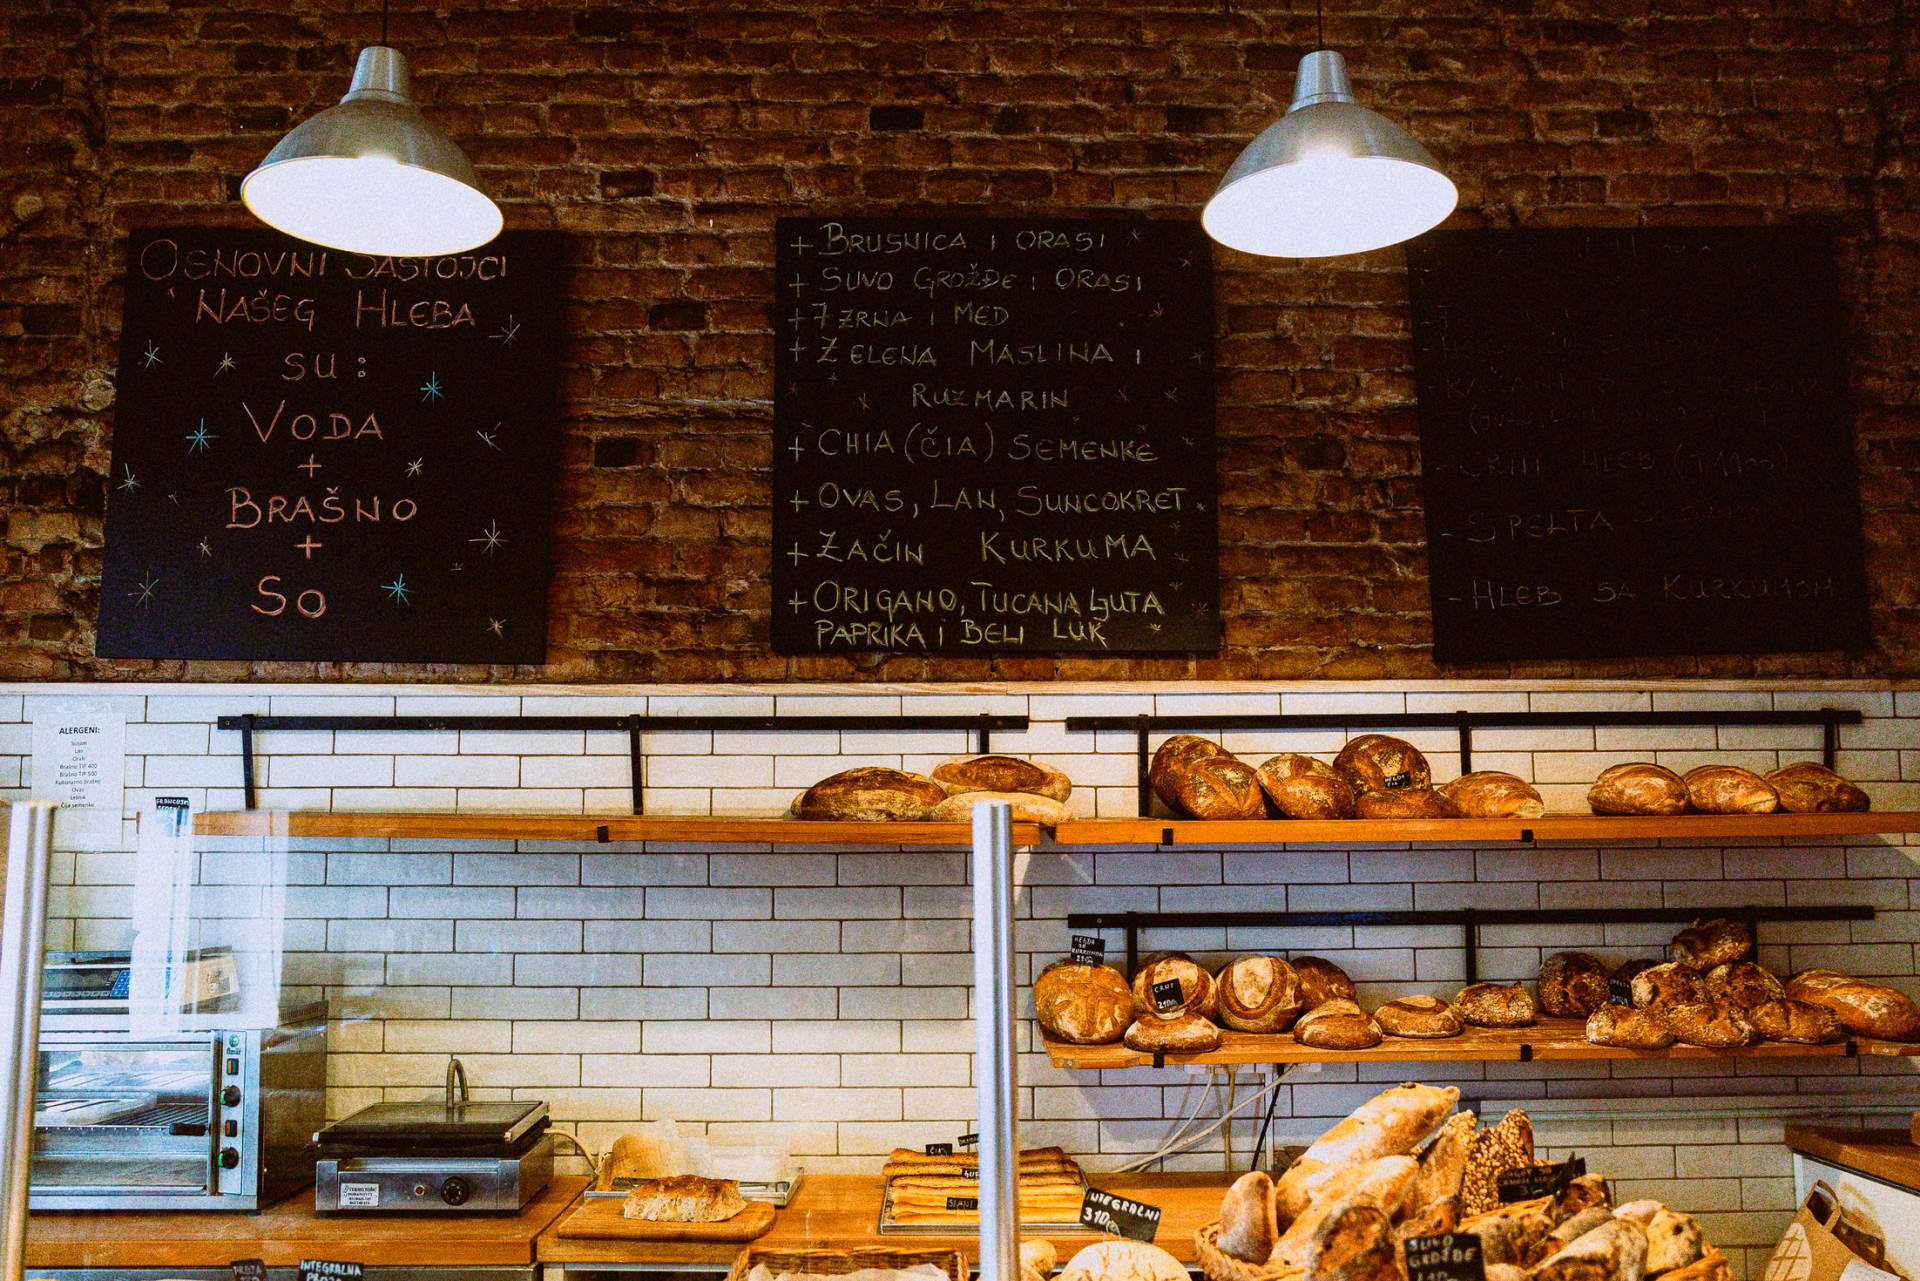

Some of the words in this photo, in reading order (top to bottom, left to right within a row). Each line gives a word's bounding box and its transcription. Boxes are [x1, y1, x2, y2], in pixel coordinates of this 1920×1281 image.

[819, 222, 966, 255] BRUSNICA
[1016, 230, 1105, 251] ORASI
[141, 237, 328, 280] OSNOVNI
[344, 254, 509, 282] SASTOJCI
[823, 267, 893, 291] SUVO
[1056, 268, 1141, 292] ORASI
[196, 288, 314, 332] NAŠEG
[356, 289, 475, 329] HLEBA
[839, 310, 911, 328] ZRNA
[955, 302, 1009, 325] MED
[817, 336, 936, 366] ZELENA
[971, 339, 1113, 365] MASLINA
[242, 400, 383, 443] VODA
[817, 430, 895, 457] CHIA
[904, 425, 995, 464] (ČIA)
[1008, 434, 1158, 462] SEMENKE
[226, 487, 417, 528] BRAŠNO
[818, 482, 918, 518] OVAS,
[930, 480, 1005, 522] LAN,
[1017, 486, 1186, 516] SUNCOKRET
[1466, 509, 1615, 544] SPELTA
[817, 529, 923, 565] ZAČIN
[981, 532, 1156, 564] KURKUMA
[251, 576, 326, 618] SO
[813, 579, 966, 621] ORIGANO,
[971, 582, 1081, 615] TUCANA
[1471, 579, 1563, 610] HLEB
[1592, 581, 1638, 603] SA
[815, 620, 927, 649] PAPRIKA
[961, 619, 1025, 646] BELI
[1053, 617, 1110, 648] LUK
[59, 726, 100, 735] ALERGENI:
